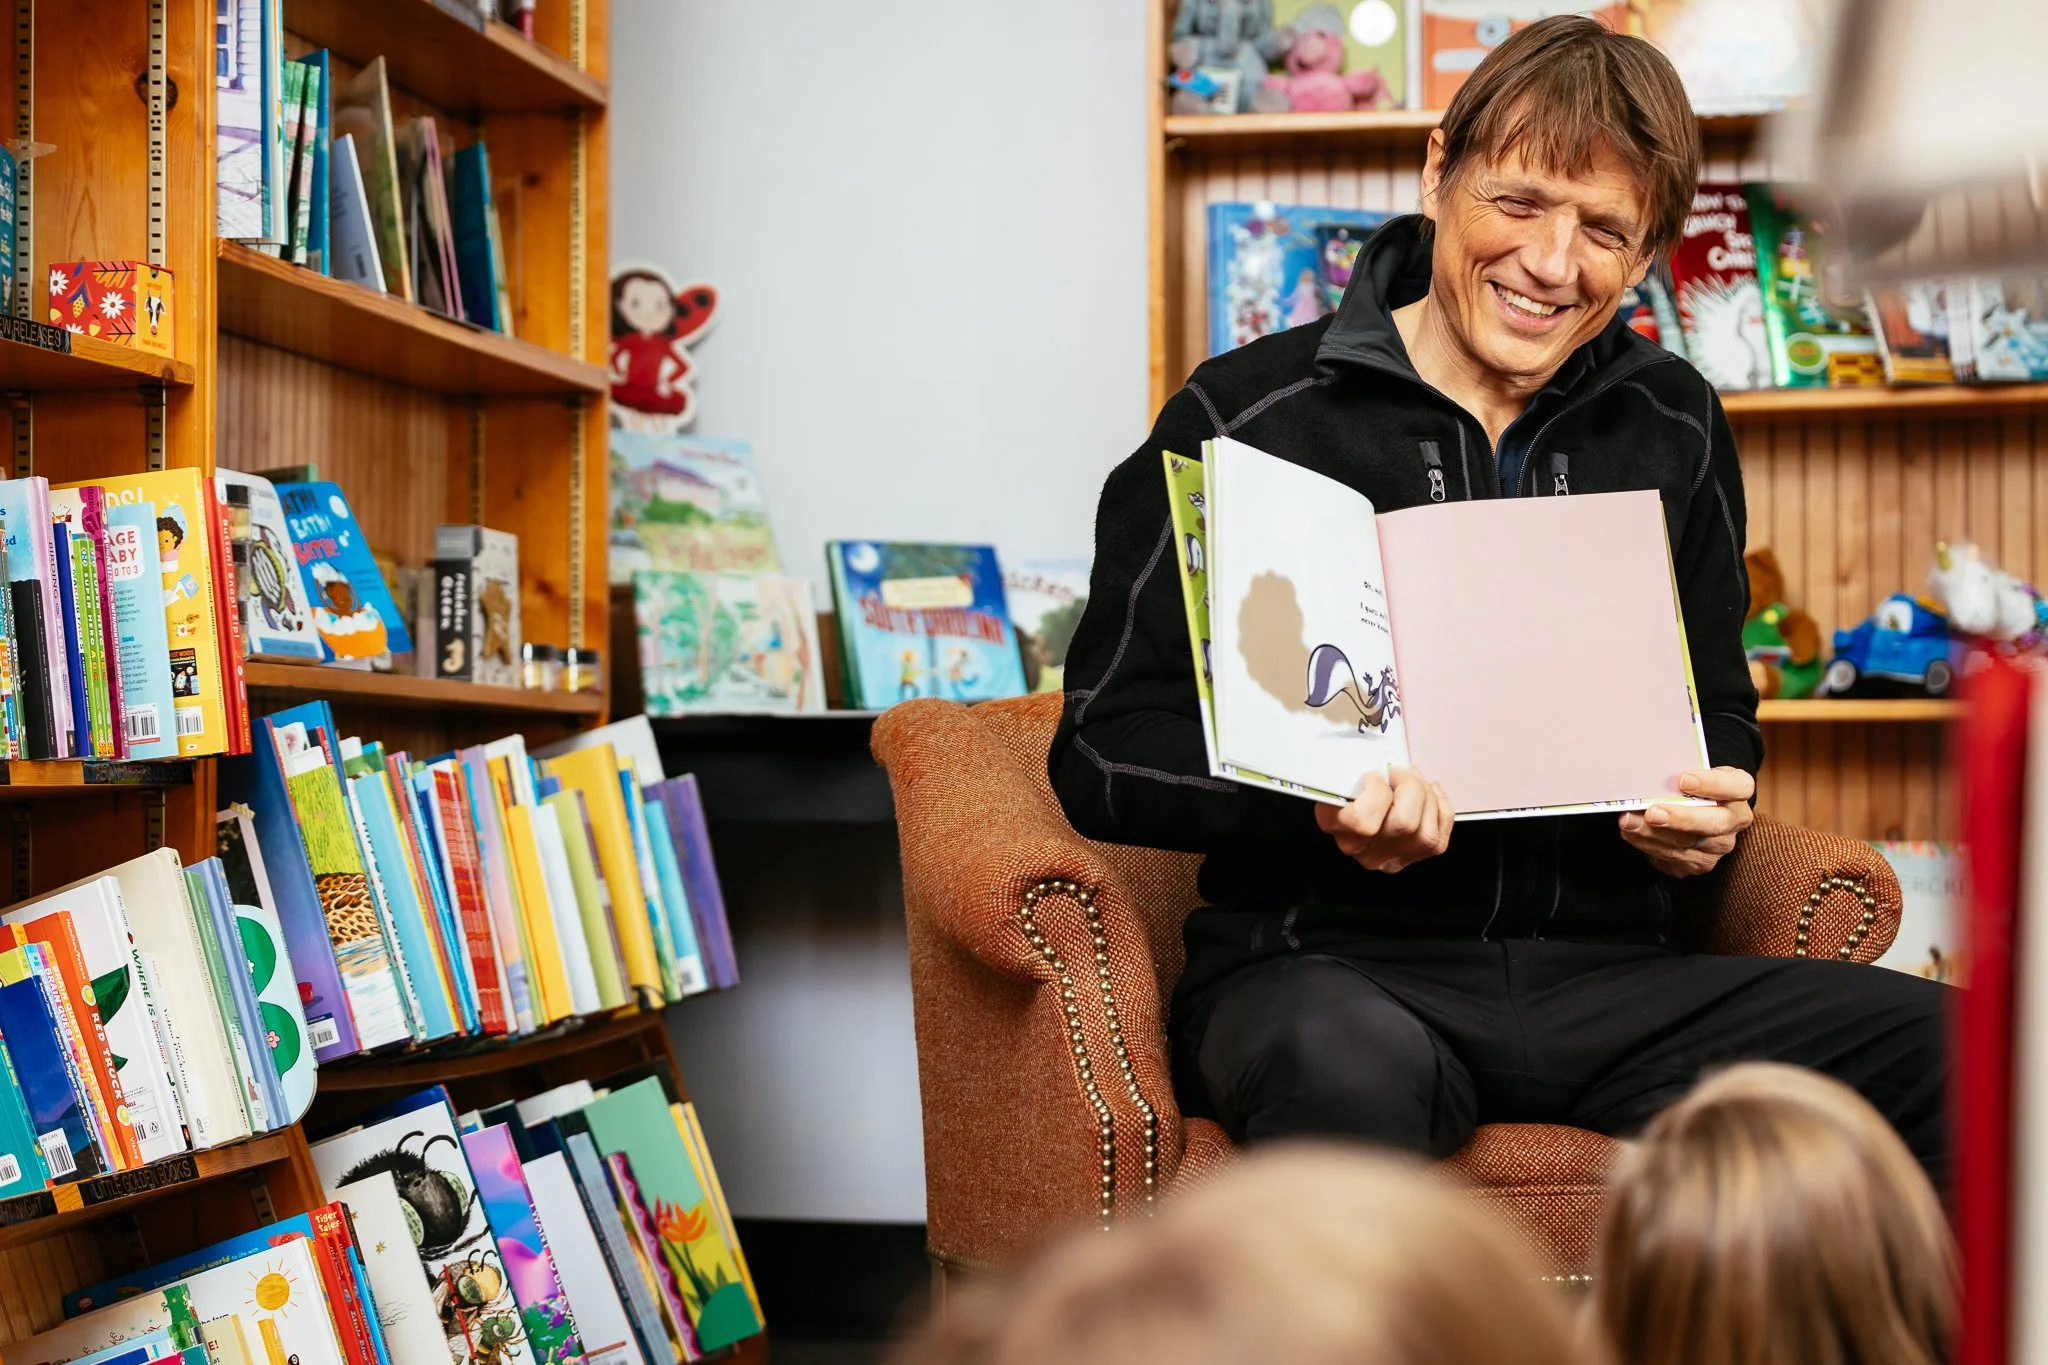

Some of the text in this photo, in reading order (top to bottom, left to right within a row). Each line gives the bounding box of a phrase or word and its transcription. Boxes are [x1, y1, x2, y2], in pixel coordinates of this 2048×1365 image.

[14, 320, 60, 348] RELEASES
[283, 488, 319, 515] ATH!
[48, 541, 58, 599] BIRDING
[133, 565, 138, 574] 3
[221, 518, 239, 637] Button! Snap! Zip!
[83, 572, 91, 608] SUPER
[120, 909, 129, 927] Carle
[131, 948, 155, 1016] WHERE IS
[44, 966, 102, 1129] BRAIN QUEST COLORS
[52, 964, 110, 1124] BRAIN QUEST SHAPES
[53, 1026, 65, 1050] Where
[61, 1050, 68, 1061] Do
[91, 1011, 122, 1099] RED TRUCK
[64, 1061, 78, 1088] Diggers
[74, 1088, 84, 1108] Sleep
[84, 1117, 96, 1142] Night?
[128, 1136, 139, 1160] Viking
[92, 1160, 191, 1199] LITTLE GOLDEN BOOKS
[315, 1210, 338, 1224] tiger
[208, 1256, 230, 1269] world
[531, 1210, 549, 1248] WANT
[546, 1254, 556, 1270] TO
[552, 1274, 564, 1292] BE
[564, 1309, 581, 1342] VASE
[348, 1309, 370, 1360] Little Blue
